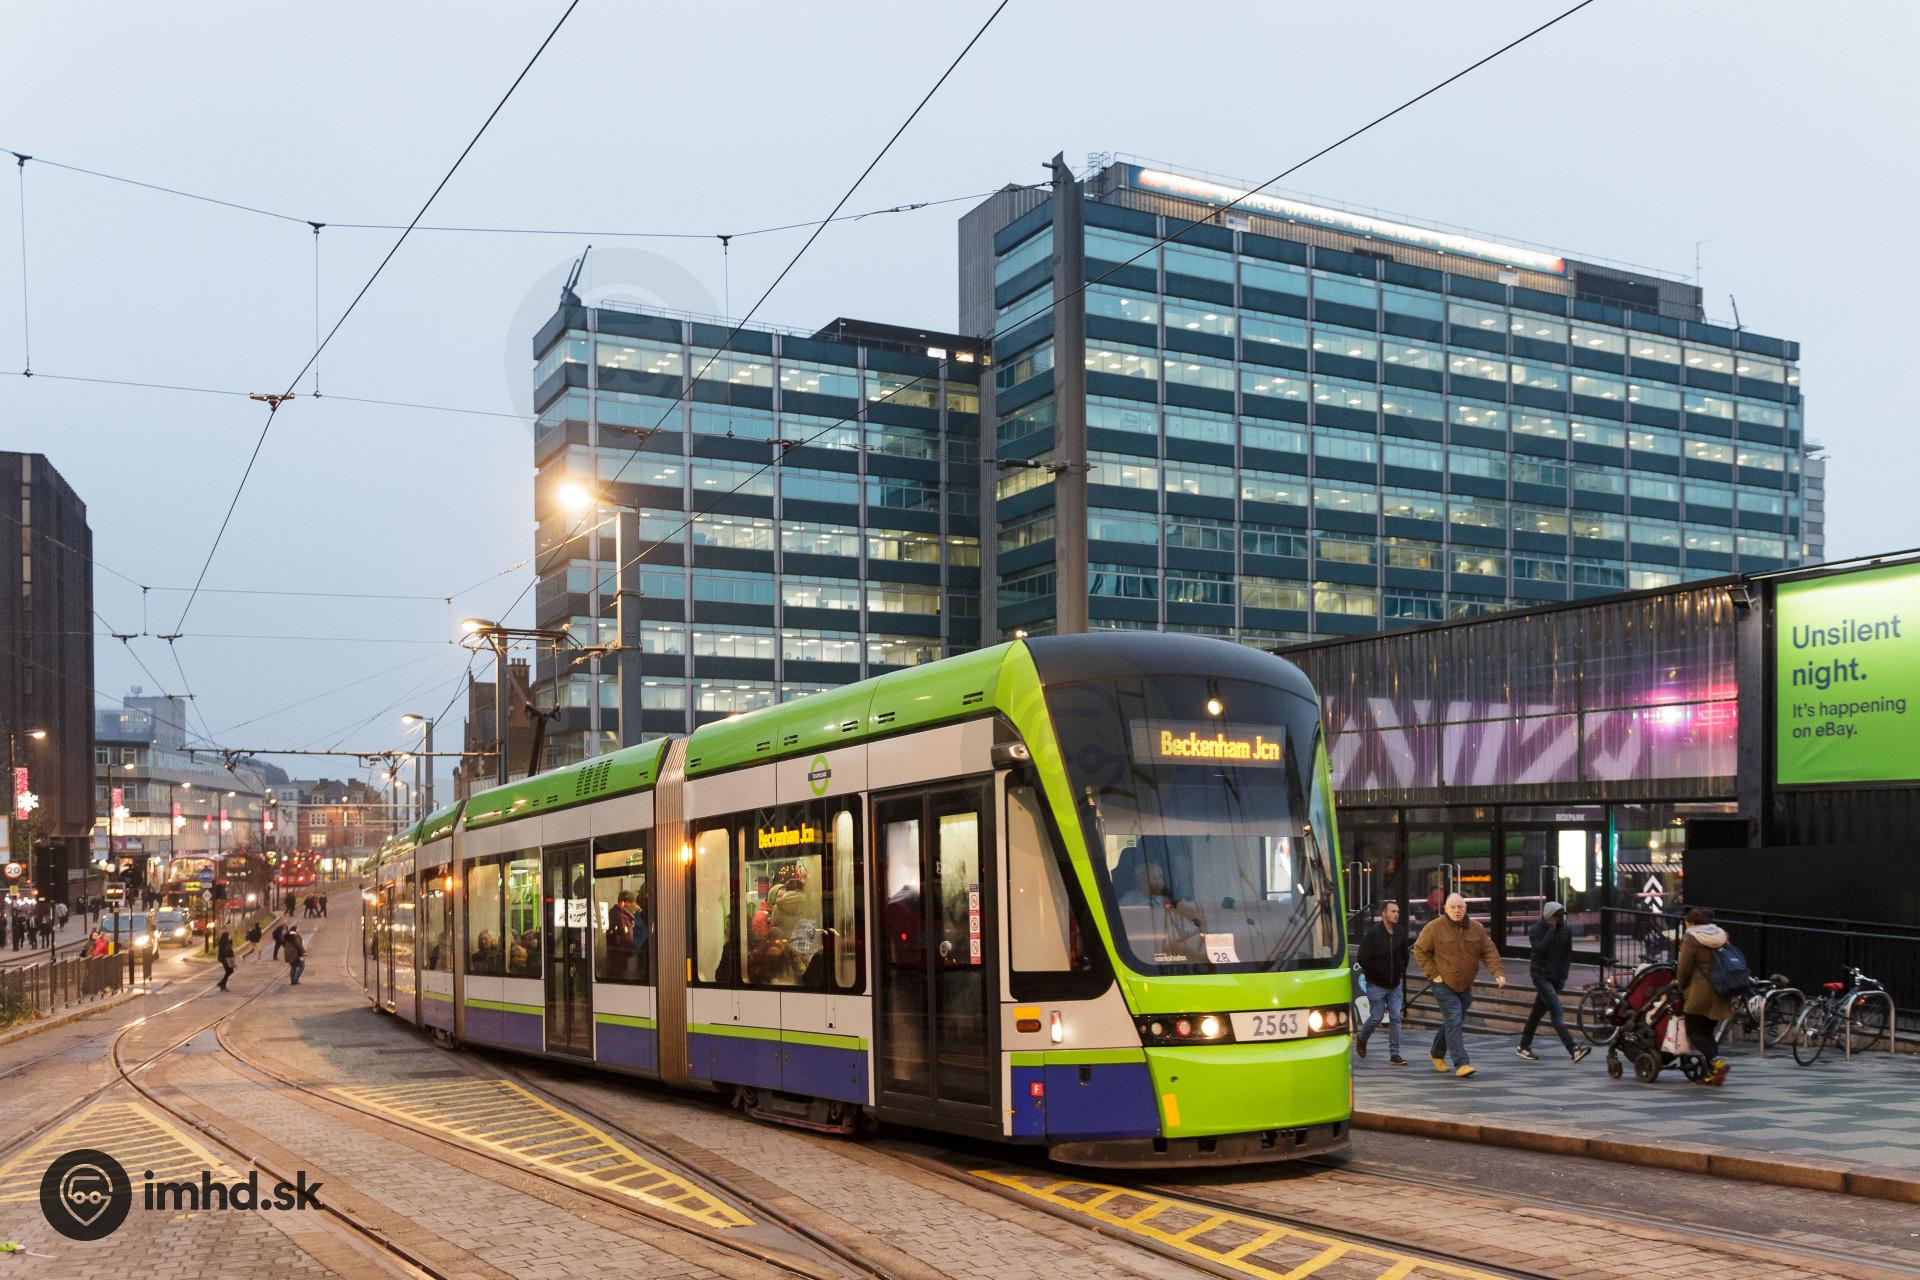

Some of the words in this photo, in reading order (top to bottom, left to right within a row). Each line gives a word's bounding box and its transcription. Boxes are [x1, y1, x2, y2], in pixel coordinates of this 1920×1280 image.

[1792, 614, 1902, 649] Unsilent
[1792, 658, 1867, 690] night.
[1793, 703, 1816, 718] It's
[1819, 696, 1907, 718] happening
[1792, 726, 1812, 739] on
[1815, 721, 1858, 739] eBay.
[1161, 730, 1251, 759] Beckenham
[1253, 735, 1280, 760] Jcn
[758, 826, 800, 849] Beckenham
[800, 822, 815, 844] Jcn
[7, 866, 20, 874] 20
[1212, 952, 1231, 963] 28
[1252, 1013, 1298, 1037] 2563
